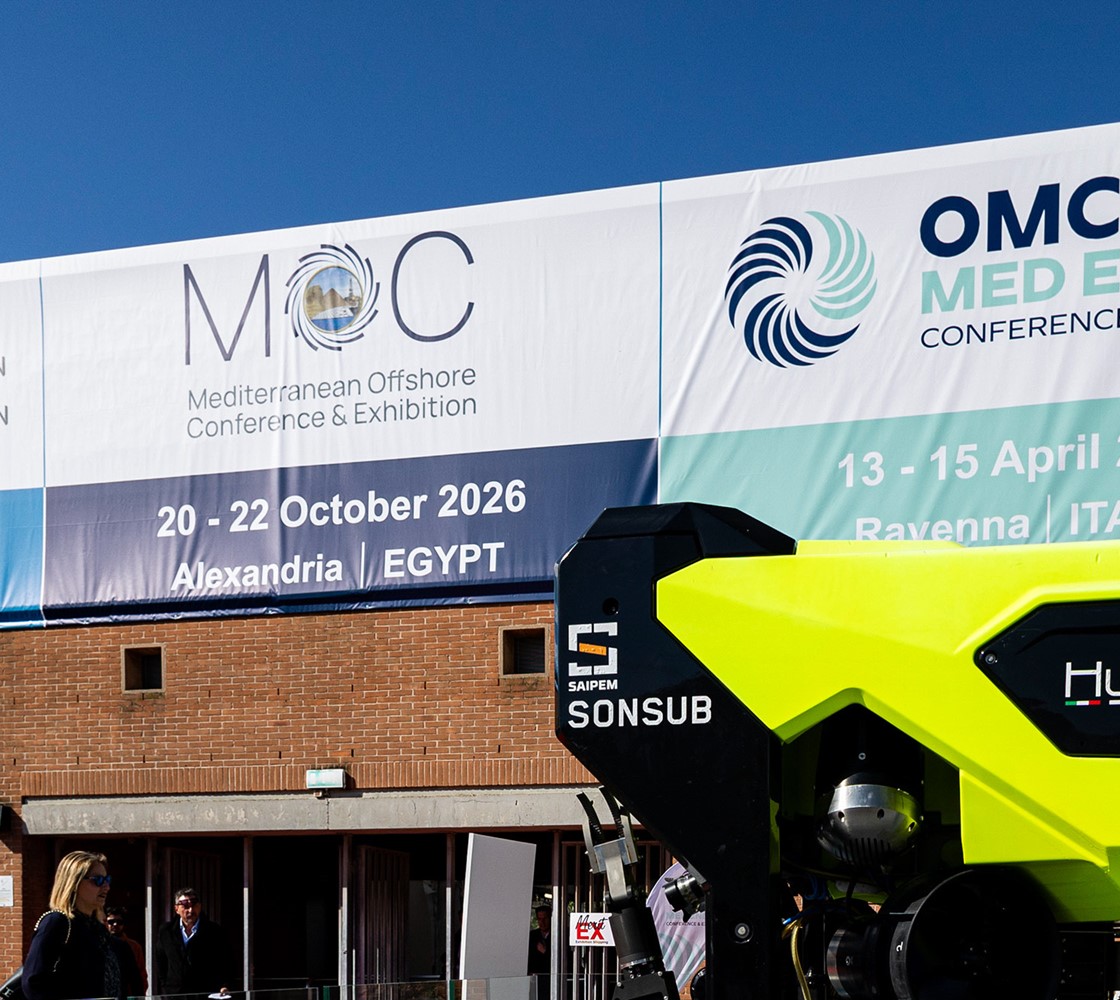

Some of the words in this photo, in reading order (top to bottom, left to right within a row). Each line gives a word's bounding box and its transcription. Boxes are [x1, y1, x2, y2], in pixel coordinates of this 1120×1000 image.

[920, 176, 1120, 258] OMC
[920, 257, 1066, 316] MED
[187, 379, 362, 410] Mediterranean
[367, 367, 476, 395] Offshore
[186, 410, 325, 439] Conference
[332, 404, 348, 427] &
[354, 396, 477, 426] Exhibition
[837, 450, 886, 489] 13
[900, 465, 915, 477] -
[929, 442, 980, 481] 15
[990, 432, 1100, 484] April
[156, 504, 197, 538] 20
[208, 518, 220, 526] -
[229, 498, 270, 533] 22
[280, 490, 430, 528] October
[437, 479, 527, 518] 2026
[854, 512, 1031, 542] Ravenna
[170, 552, 343, 592] Alexandria
[382, 541, 506, 580] EGYPT
[567, 678, 619, 693] SAIPEM
[567, 695, 713, 729] SONSUB
